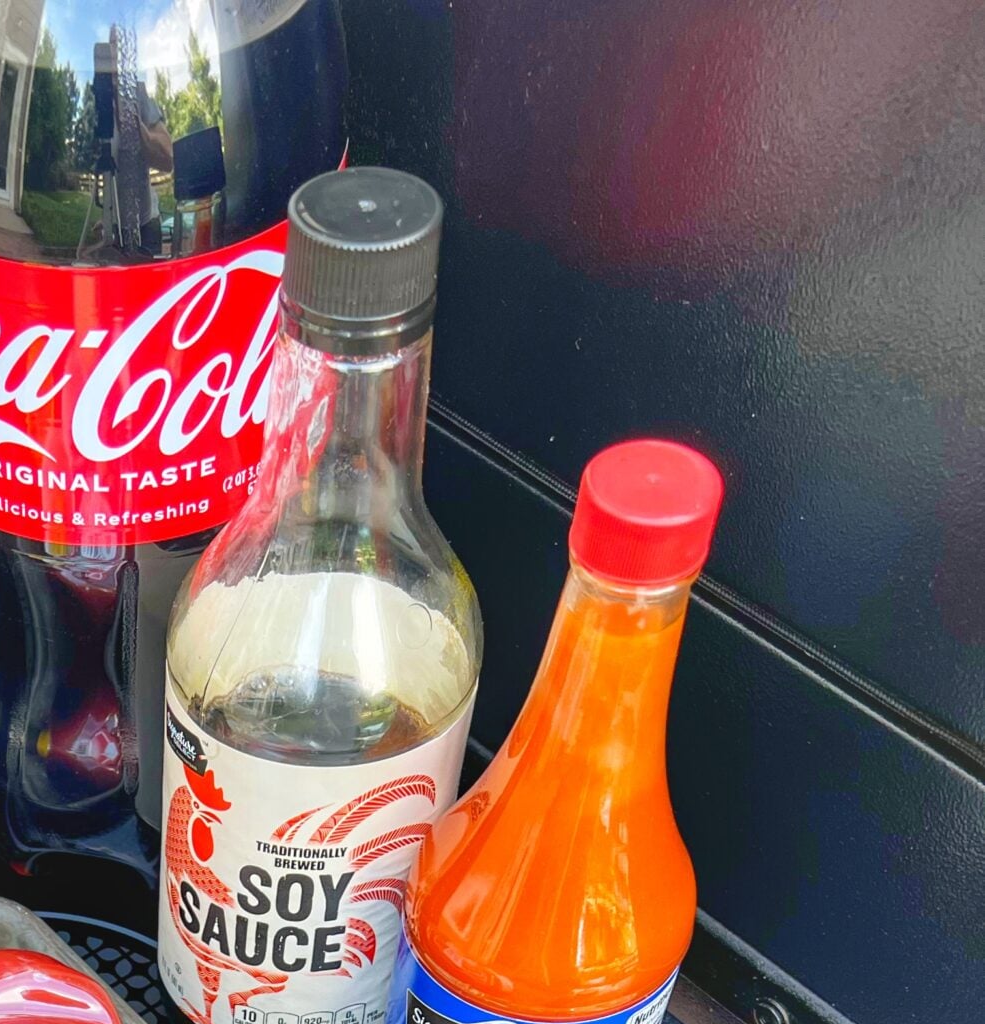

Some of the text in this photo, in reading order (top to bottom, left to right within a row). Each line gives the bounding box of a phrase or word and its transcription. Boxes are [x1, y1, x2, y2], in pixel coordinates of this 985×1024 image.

[120, 456, 216, 492] TASTE
[222, 475, 233, 493] (2
[235, 469, 247, 486] QT
[71, 511, 86, 525] &
[94, 499, 210, 526] Refreshing
[256, 840, 348, 860] TRADITIONALLY
[274, 857, 325, 871] BREWED
[237, 864, 354, 923] SOY
[179, 881, 346, 973] SAUCE
[241, 1009, 257, 1023] 10
